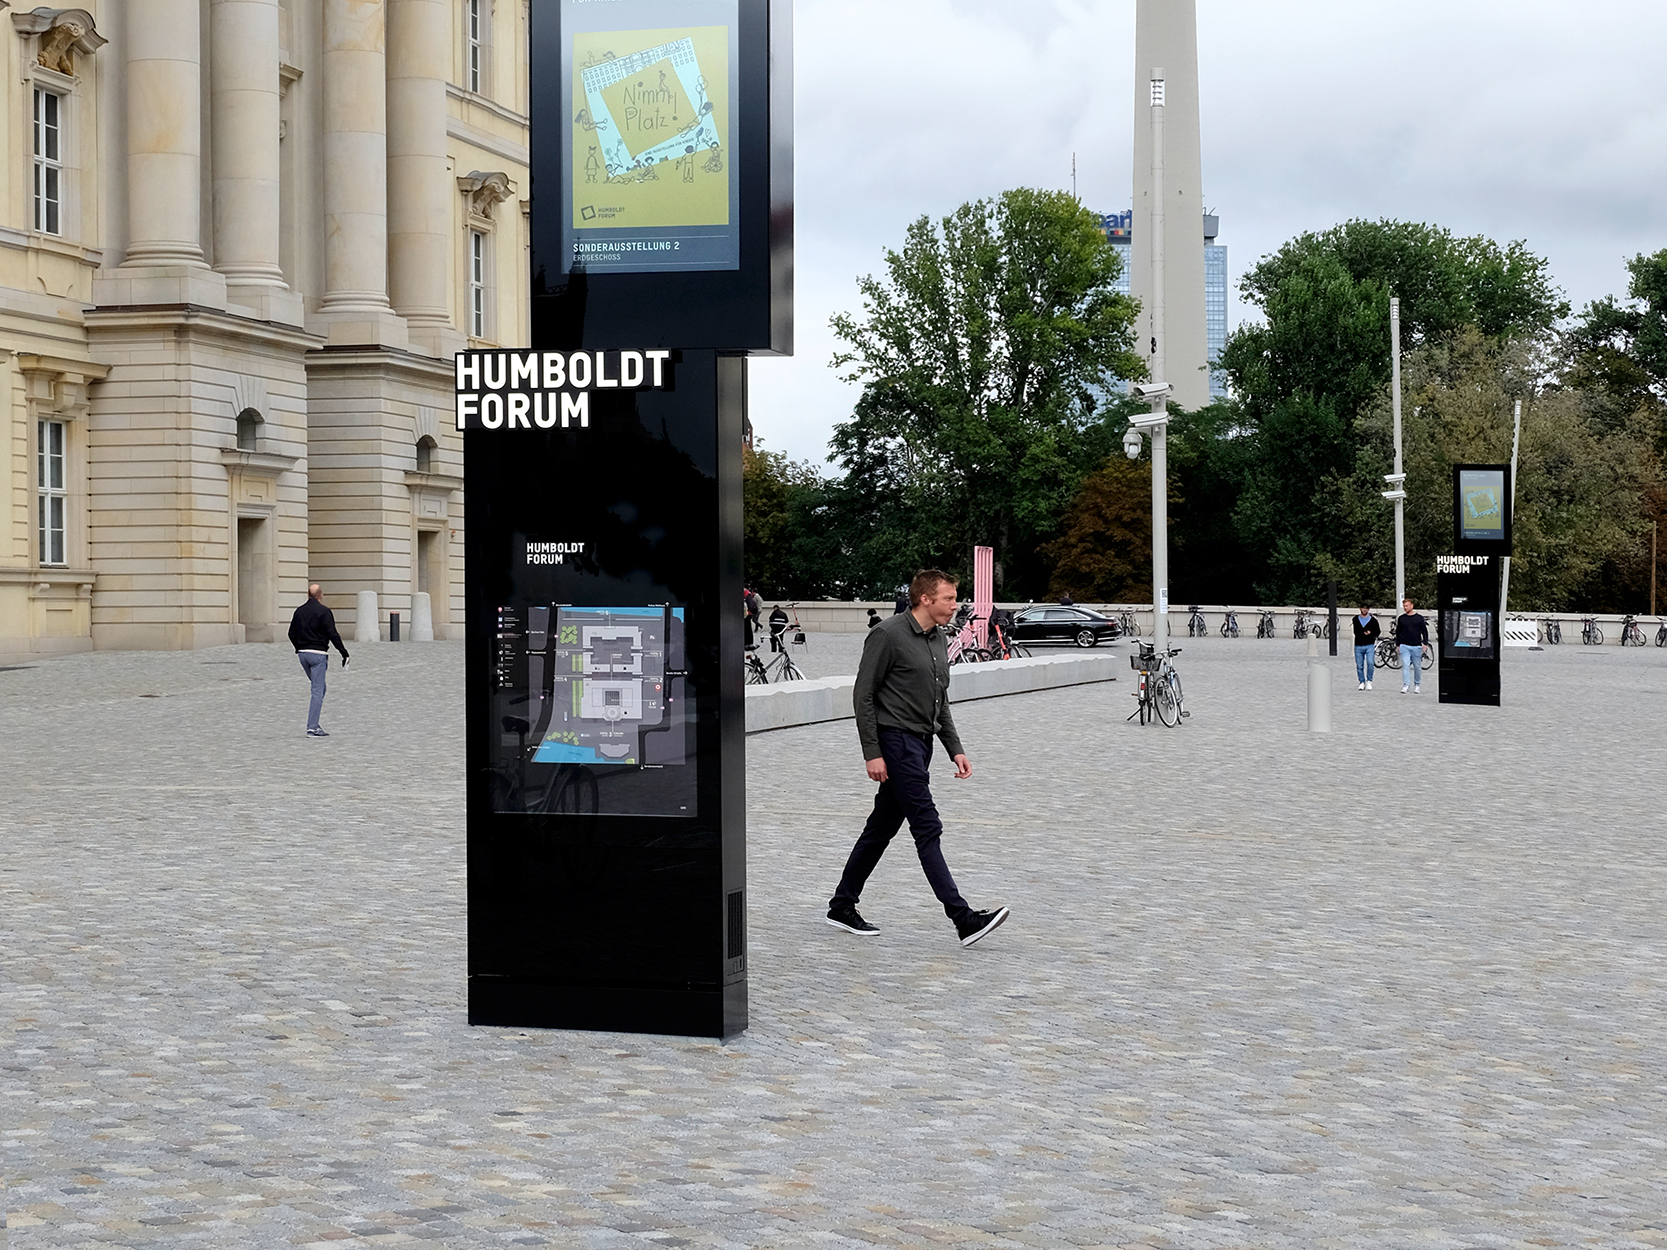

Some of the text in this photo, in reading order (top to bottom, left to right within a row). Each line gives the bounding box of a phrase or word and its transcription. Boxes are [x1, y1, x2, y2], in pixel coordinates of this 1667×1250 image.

[623, 82, 671, 105] Nimm
[573, 241, 680, 252] SONDERAUSSTELLUNG 2
[573, 253, 621, 261] ERDGESCHOSS
[456, 350, 670, 390] HUMBOLDT
[457, 392, 589, 430] FORUM
[526, 542, 585, 553] HUMBOLDT
[526, 554, 564, 565] FORUM
[1436, 555, 1489, 565] HUMBOLDT
[1437, 565, 1470, 574] FORUM
